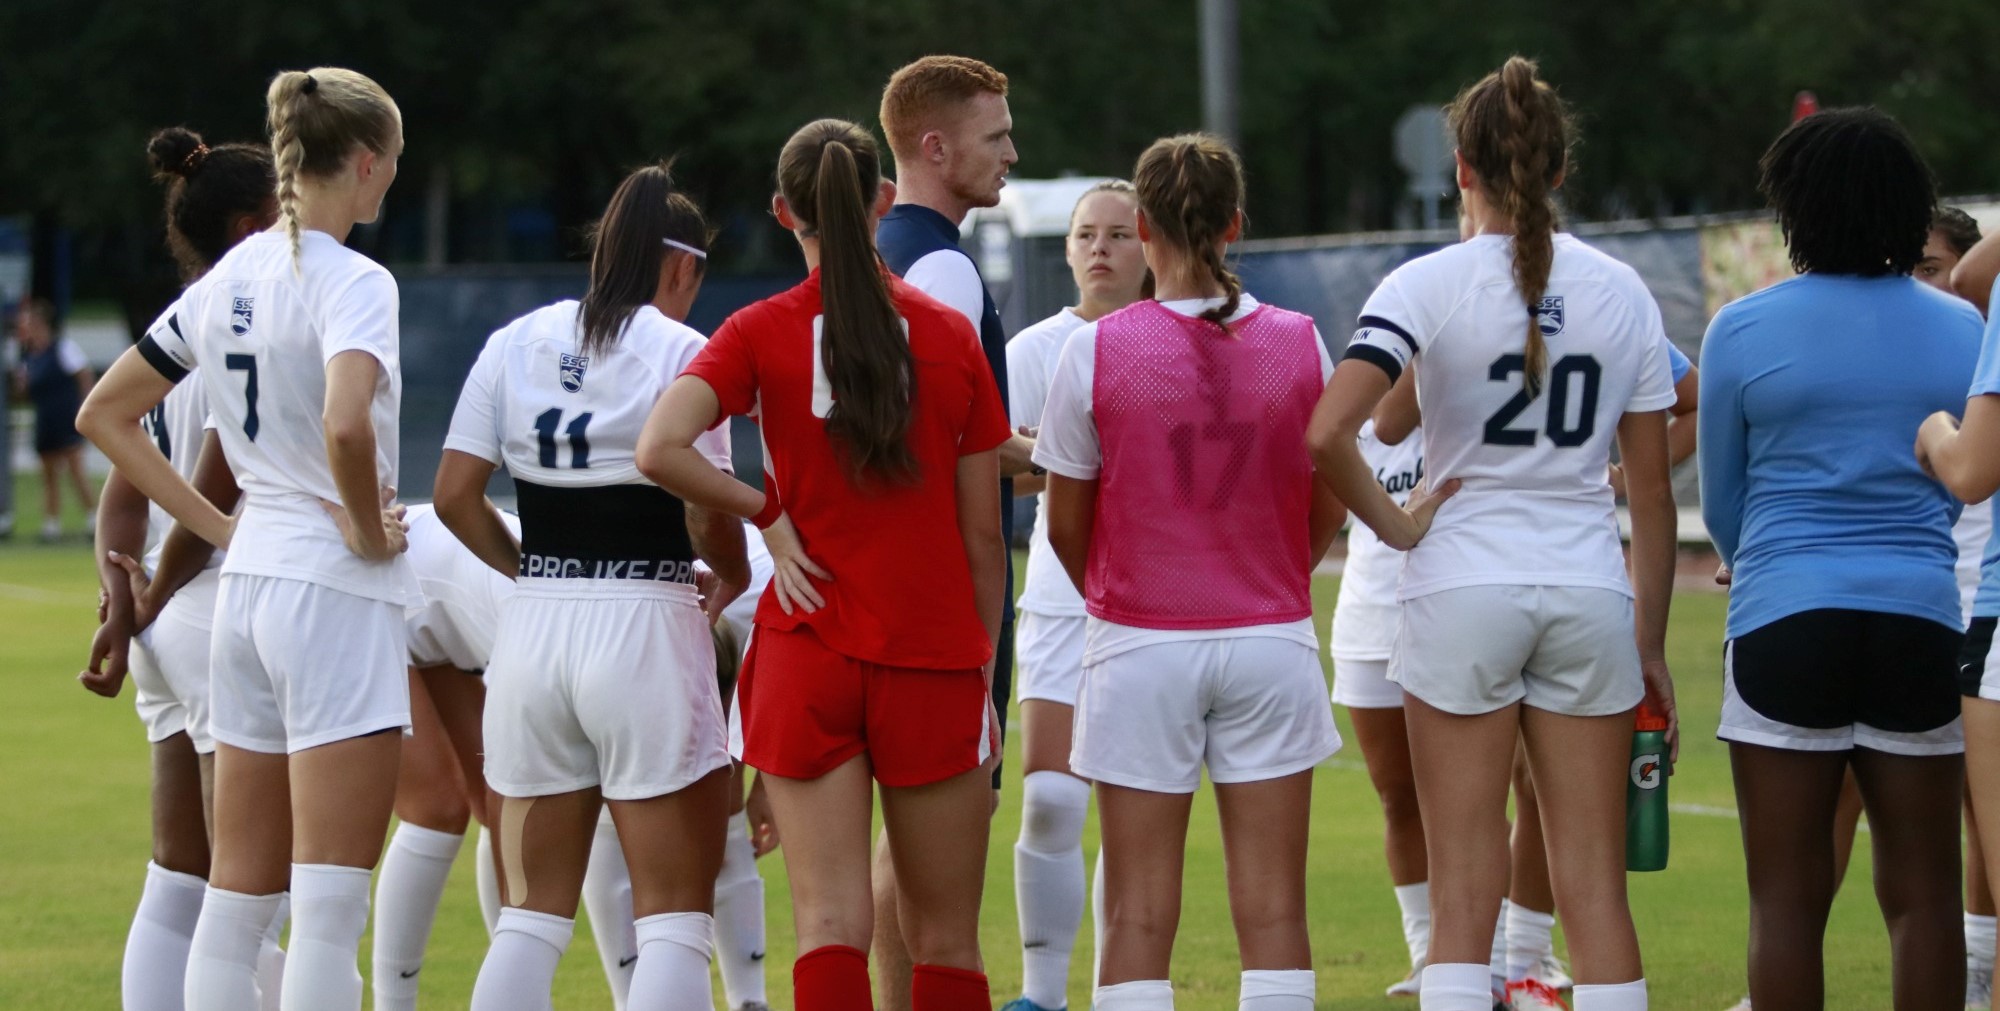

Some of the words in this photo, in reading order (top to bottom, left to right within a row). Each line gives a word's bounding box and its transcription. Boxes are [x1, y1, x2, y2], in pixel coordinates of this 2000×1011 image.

[1537, 298, 1562, 309] SSC
[561, 356, 587, 369] SSC
[225, 353, 259, 442] 7
[1482, 353, 1602, 448] 20
[534, 407, 594, 469] 11
[1168, 420, 1257, 510] 17
[1630, 753, 1660, 790] G
